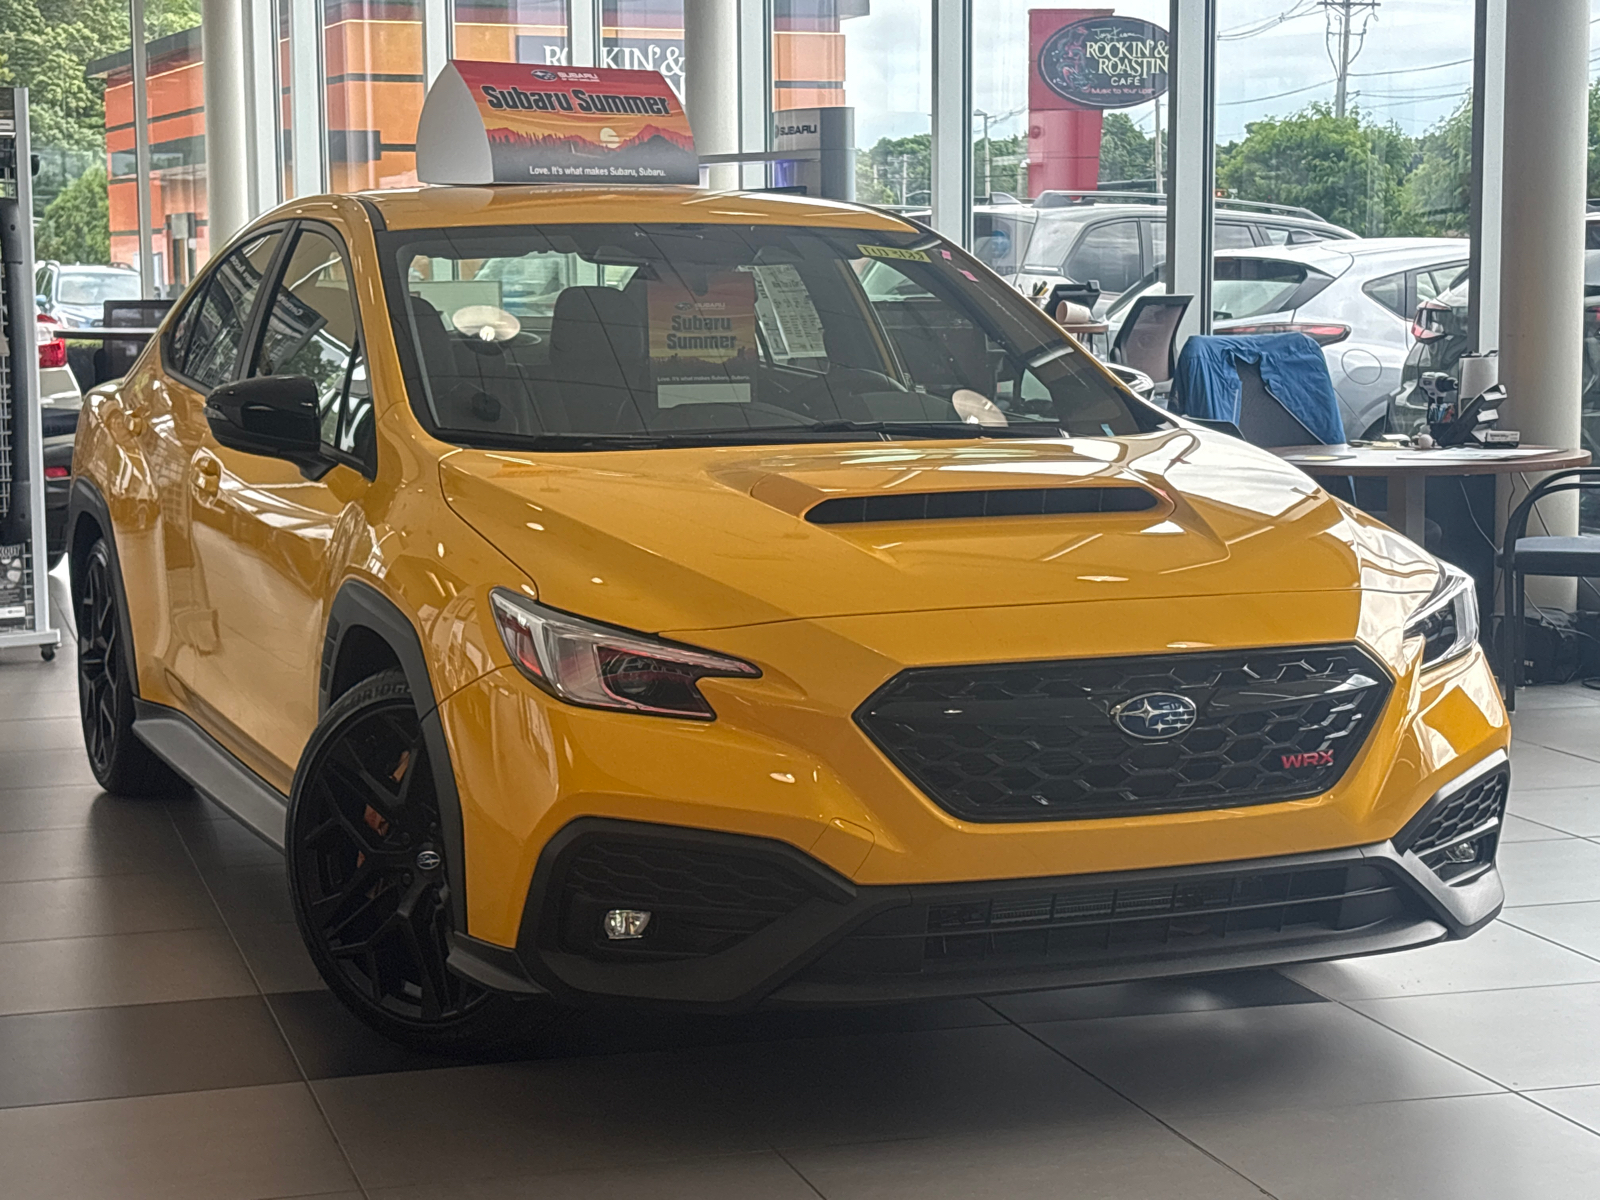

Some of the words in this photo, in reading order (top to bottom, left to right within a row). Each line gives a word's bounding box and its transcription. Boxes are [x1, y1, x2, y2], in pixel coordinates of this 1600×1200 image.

[1086, 39, 1154, 61] ROCKIN'
[1154, 40, 1169, 60] &
[557, 71, 600, 80] SUBARU
[1110, 76, 1141, 86] CAFÉ
[481, 85, 574, 112] Subaru
[571, 89, 671, 115] Summer
[529, 166, 551, 175] Love.
[551, 166, 563, 175] It's
[564, 167, 583, 175] what
[584, 167, 609, 176] makes
[609, 167, 638, 177] Subaru,
[638, 168, 667, 177] Subaru.
[671, 314, 732, 332] Subaru
[666, 333, 737, 350] Summer
[1281, 749, 1334, 769] WRX
